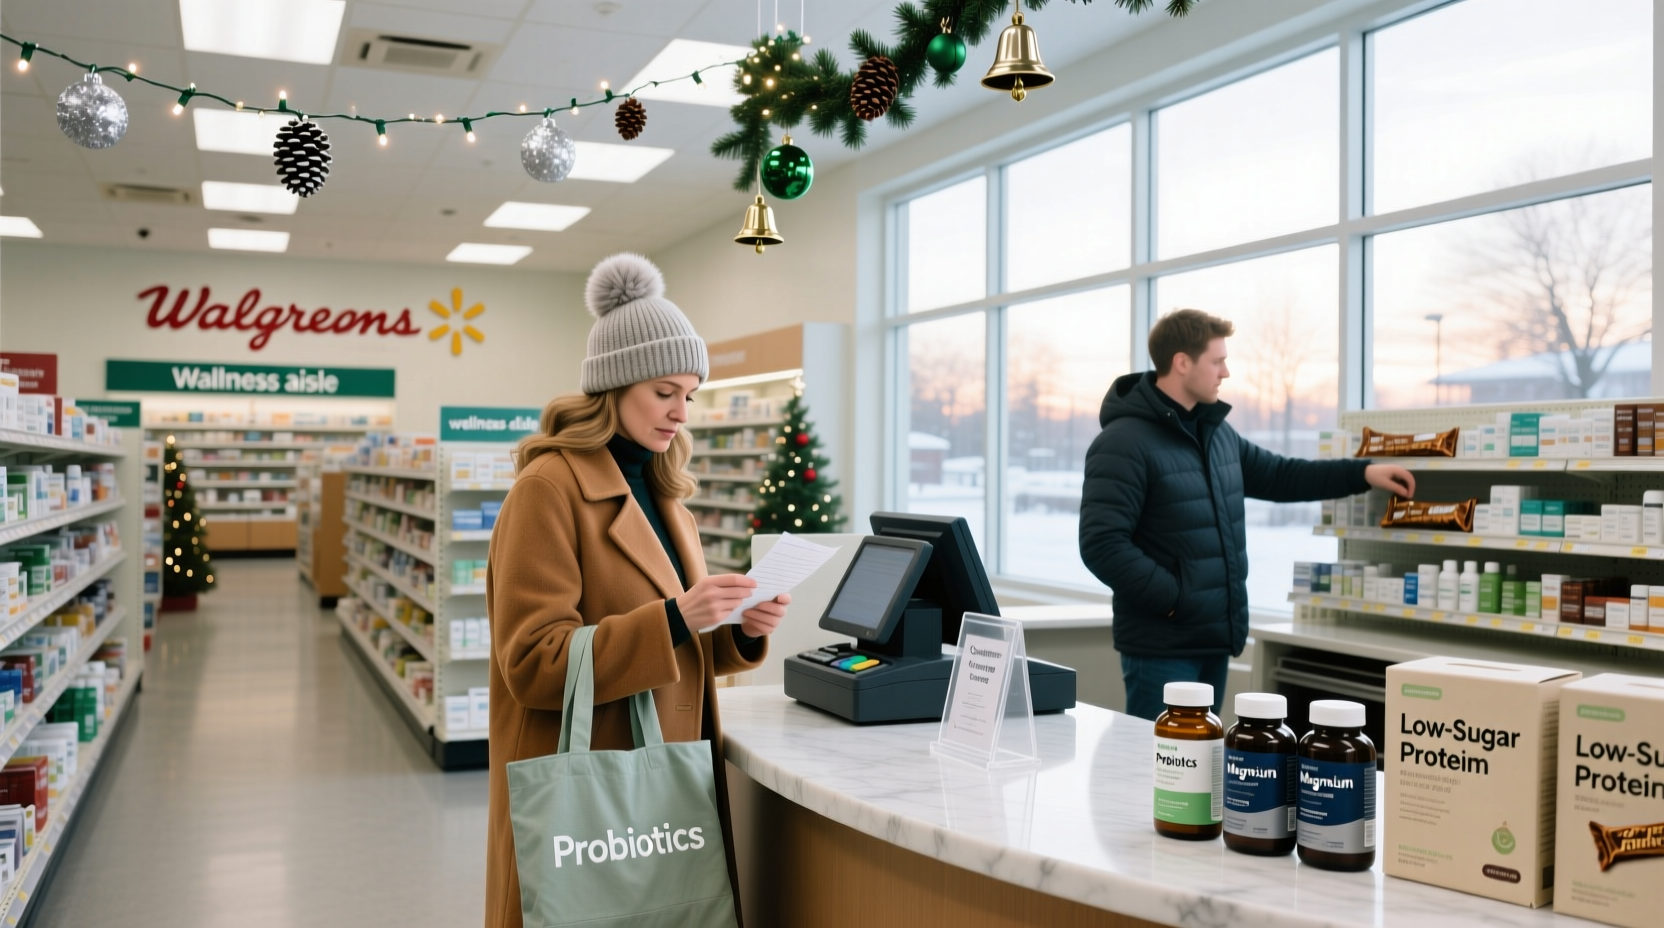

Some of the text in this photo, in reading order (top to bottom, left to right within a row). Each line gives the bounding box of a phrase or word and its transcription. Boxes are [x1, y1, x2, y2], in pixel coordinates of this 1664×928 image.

[284, 368, 340, 394] aisle
[1400, 712, 1521, 751] Low-Sugar
[1400, 741, 1489, 775] Proteim
[553, 822, 705, 868] Probiotics
